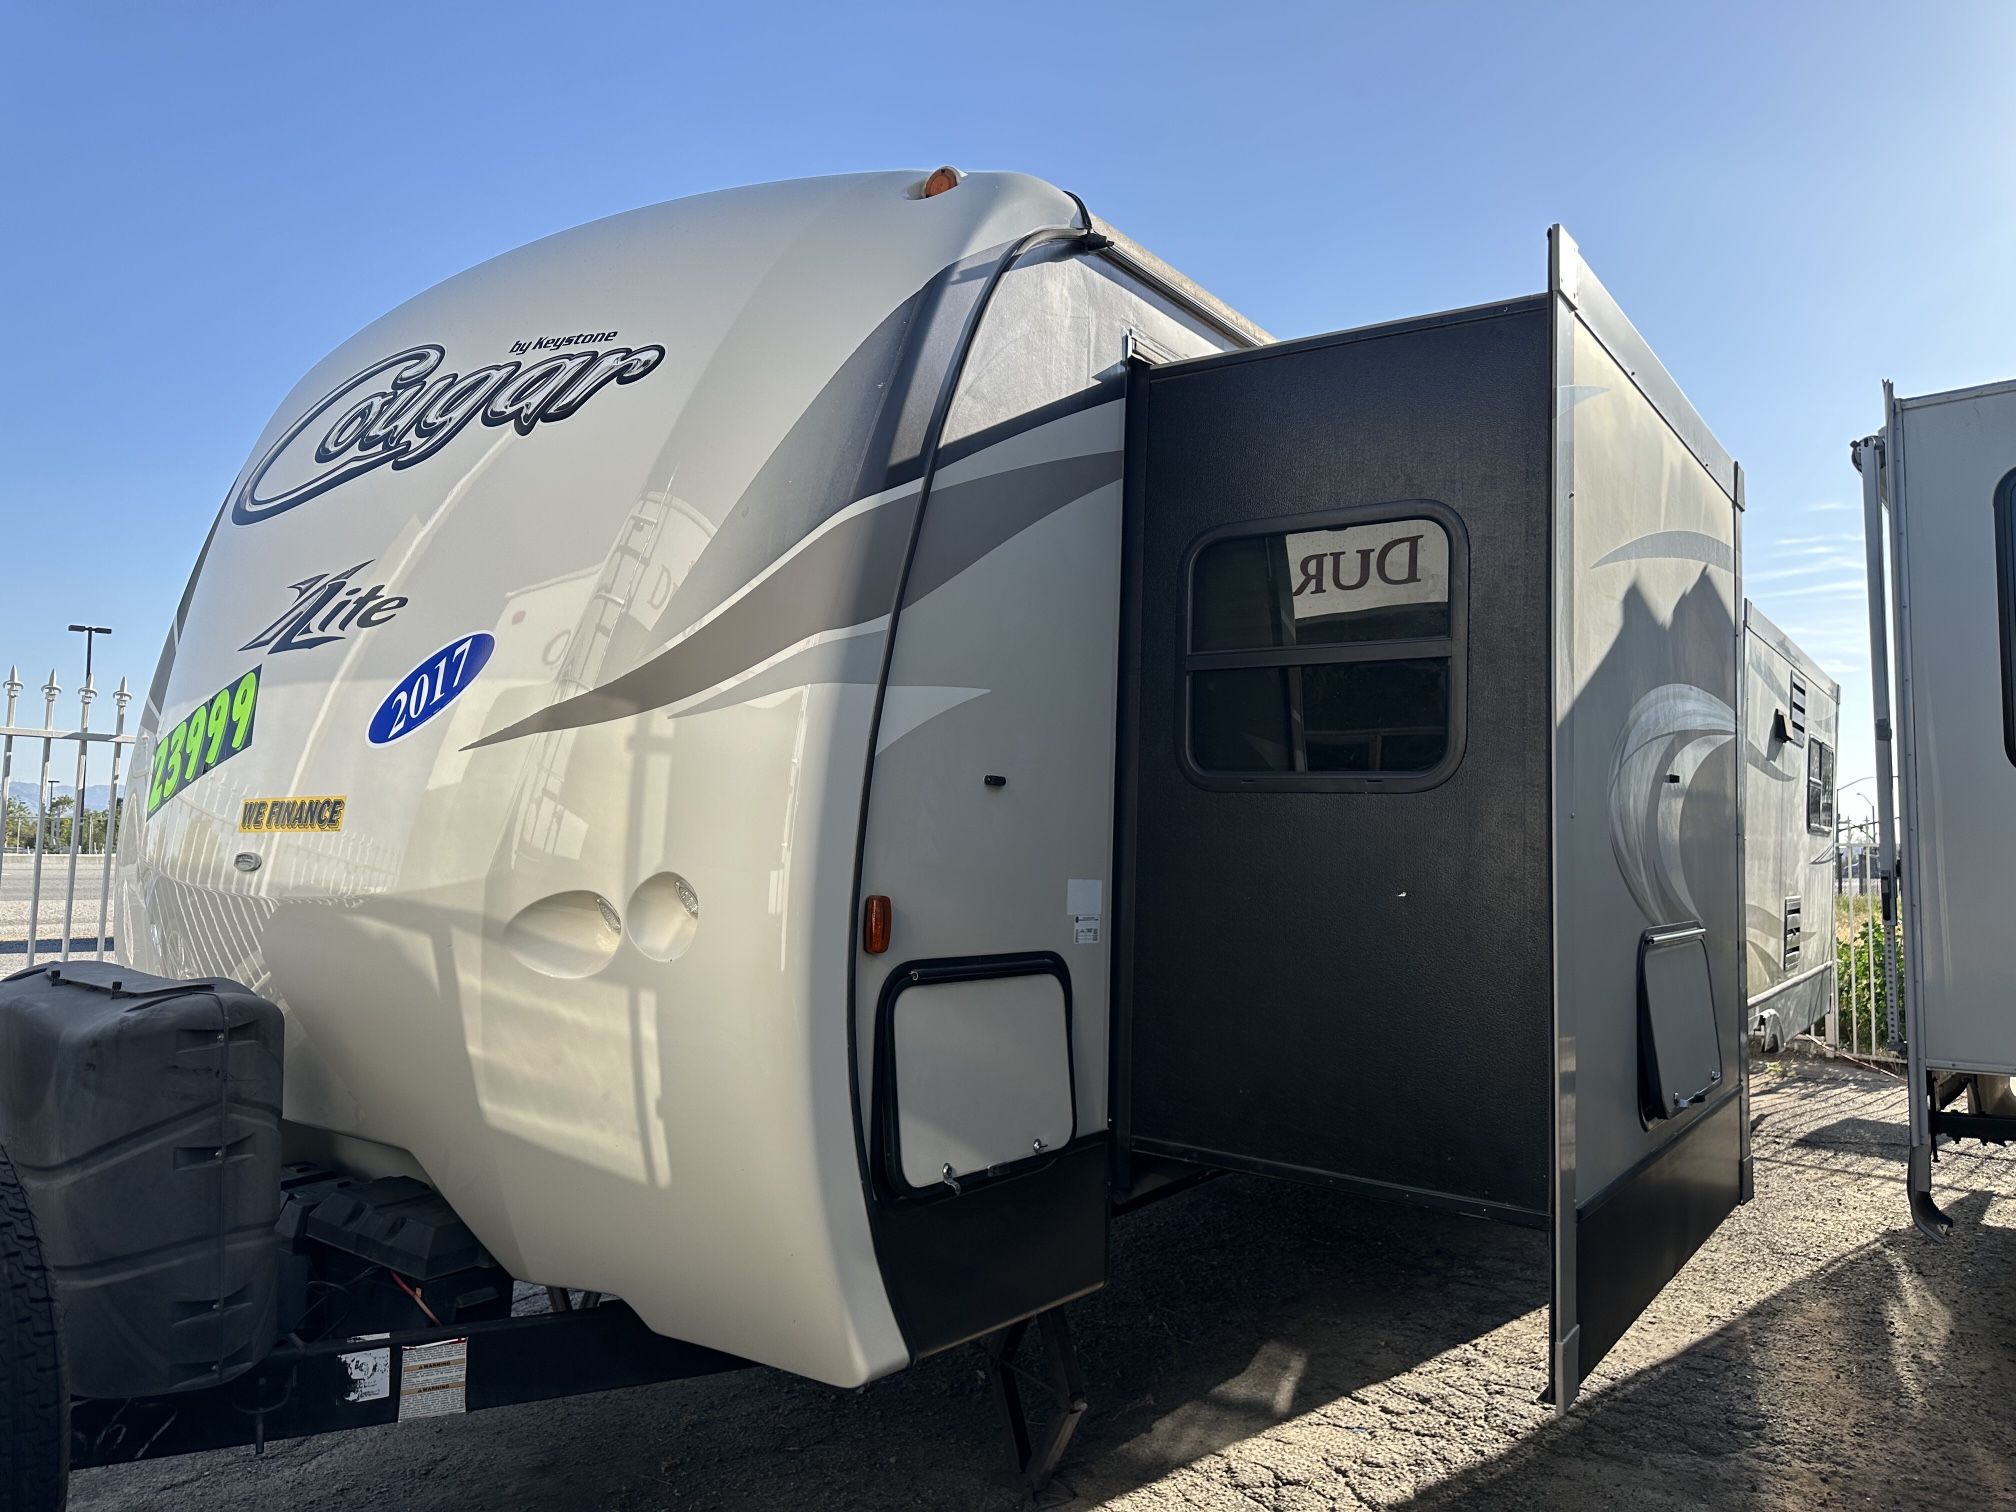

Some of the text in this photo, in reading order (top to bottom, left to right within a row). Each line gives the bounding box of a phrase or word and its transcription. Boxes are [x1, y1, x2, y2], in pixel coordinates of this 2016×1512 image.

[508, 331, 618, 356] by Keystone
[231, 343, 667, 526] Cougar
[387, 636, 474, 739] 2017
[148, 671, 258, 812] 23999
[241, 798, 346, 830] WE FINANCE
[424, 1360, 451, 1369] WARNING
[423, 1383, 450, 1392] WARNING
